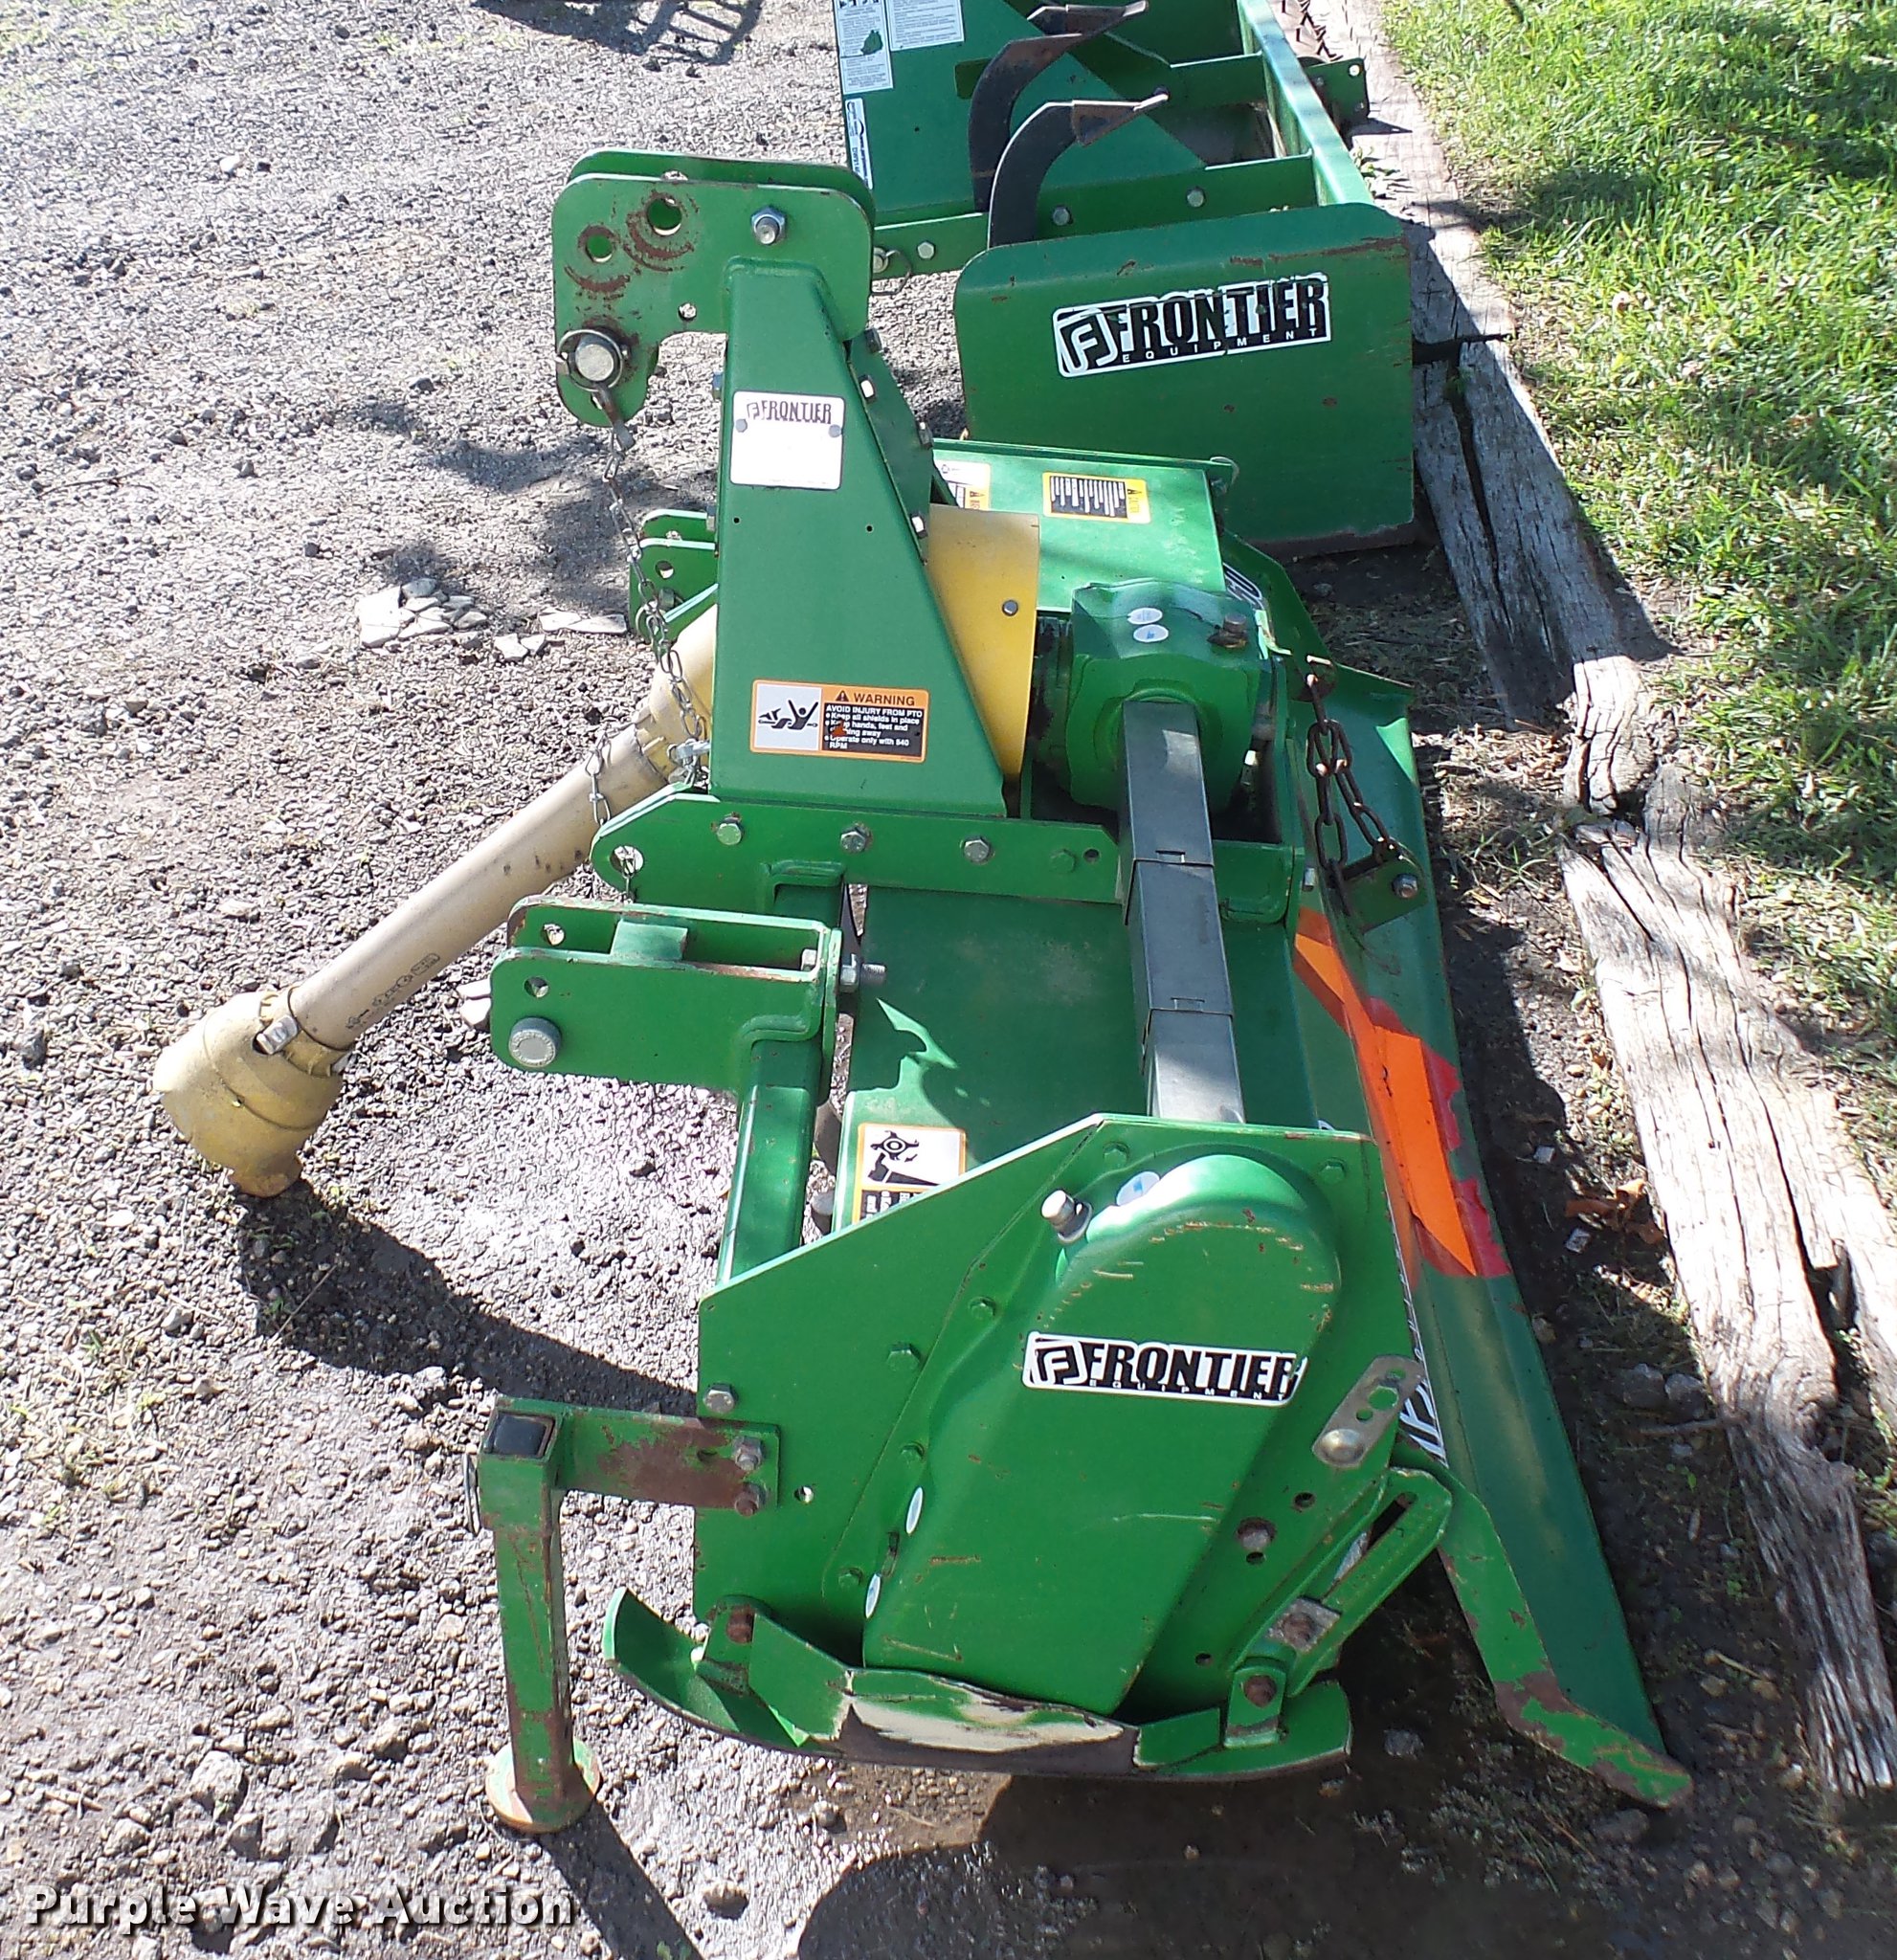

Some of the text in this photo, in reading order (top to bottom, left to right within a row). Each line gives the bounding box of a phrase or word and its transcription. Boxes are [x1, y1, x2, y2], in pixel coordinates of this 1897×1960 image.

[1106, 278, 1327, 353] FRONTIER
[1122, 328, 1318, 364] EQUIPMENT
[761, 400, 832, 424] FRONTIER
[826, 704, 851, 713] AVOID
[852, 706, 881, 715] INJURY
[854, 693, 915, 706] WARNING
[830, 720, 850, 728] Kp
[1082, 1342, 1297, 1398] FRONTIER
[1089, 1378, 1285, 1401] EQUIPMENT
